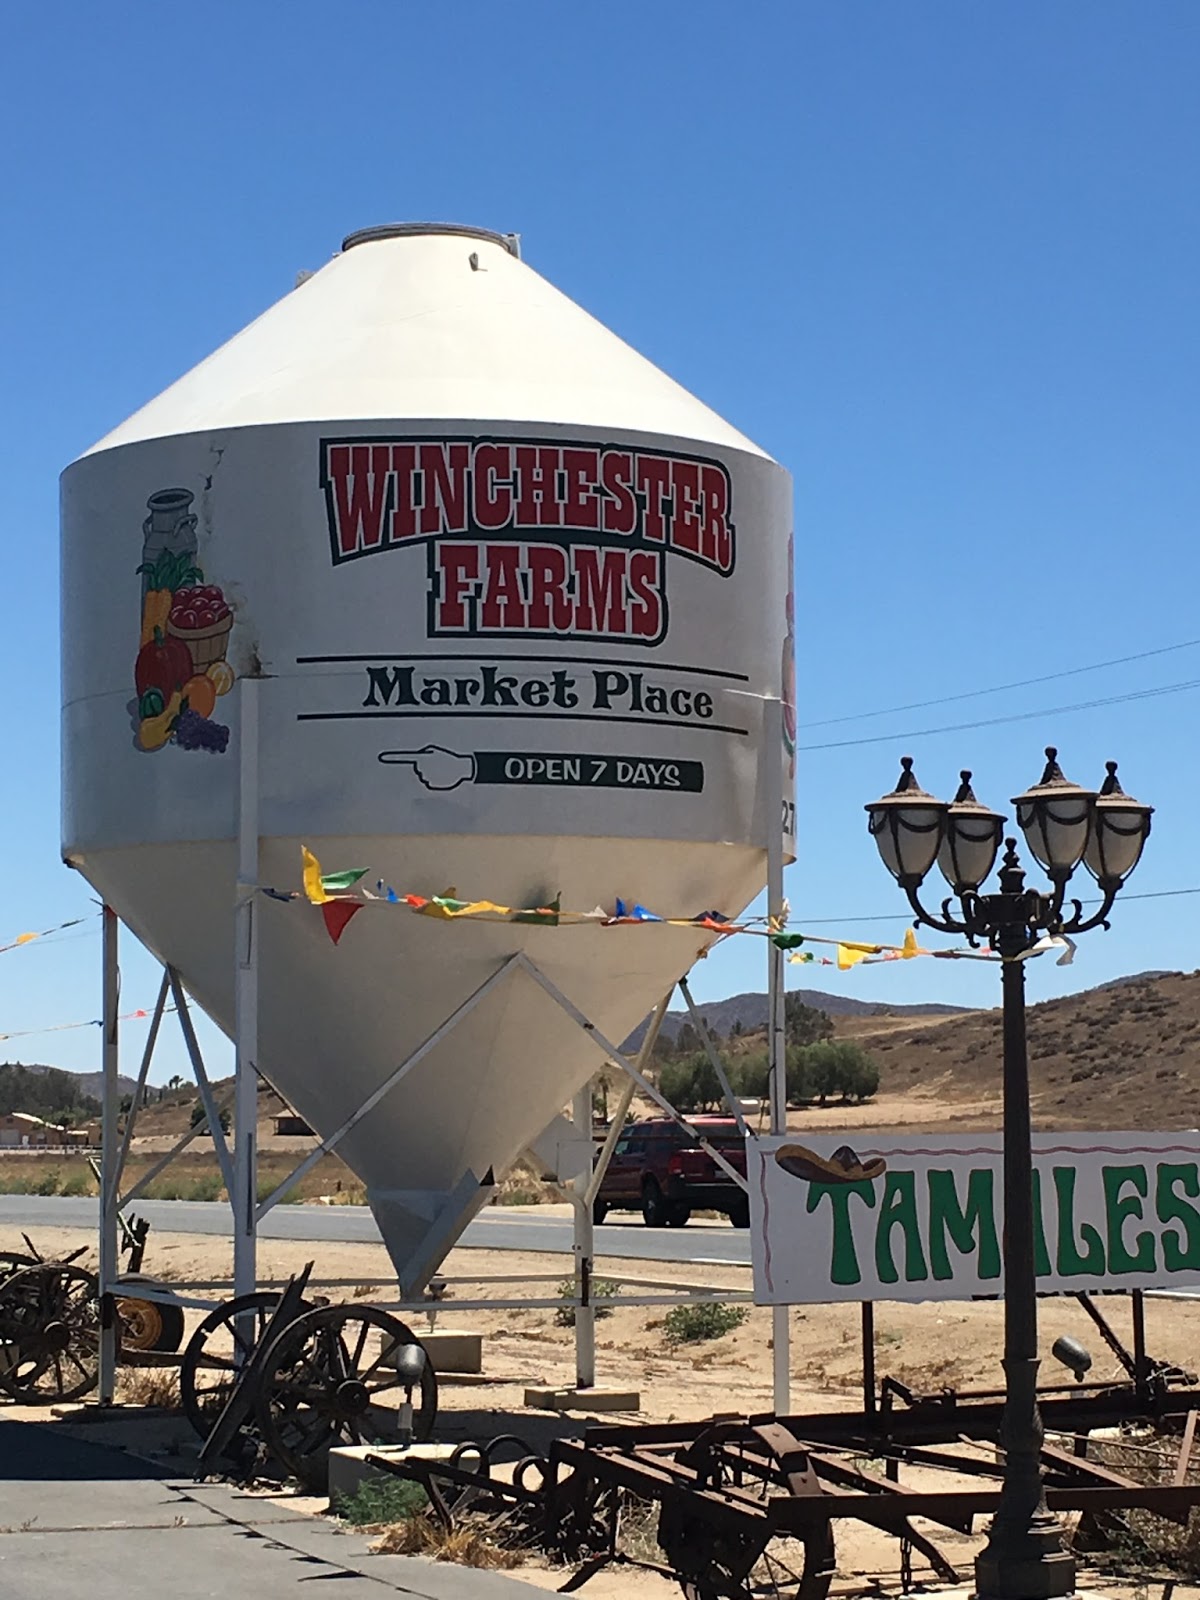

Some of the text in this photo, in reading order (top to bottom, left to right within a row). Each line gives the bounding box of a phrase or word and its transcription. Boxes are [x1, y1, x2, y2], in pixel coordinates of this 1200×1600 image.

[322, 438, 735, 575] WINCHESTER
[428, 540, 665, 643] FARMS
[363, 666, 713, 717] Market Place
[504, 757, 681, 787] OPEN 7 DAYS
